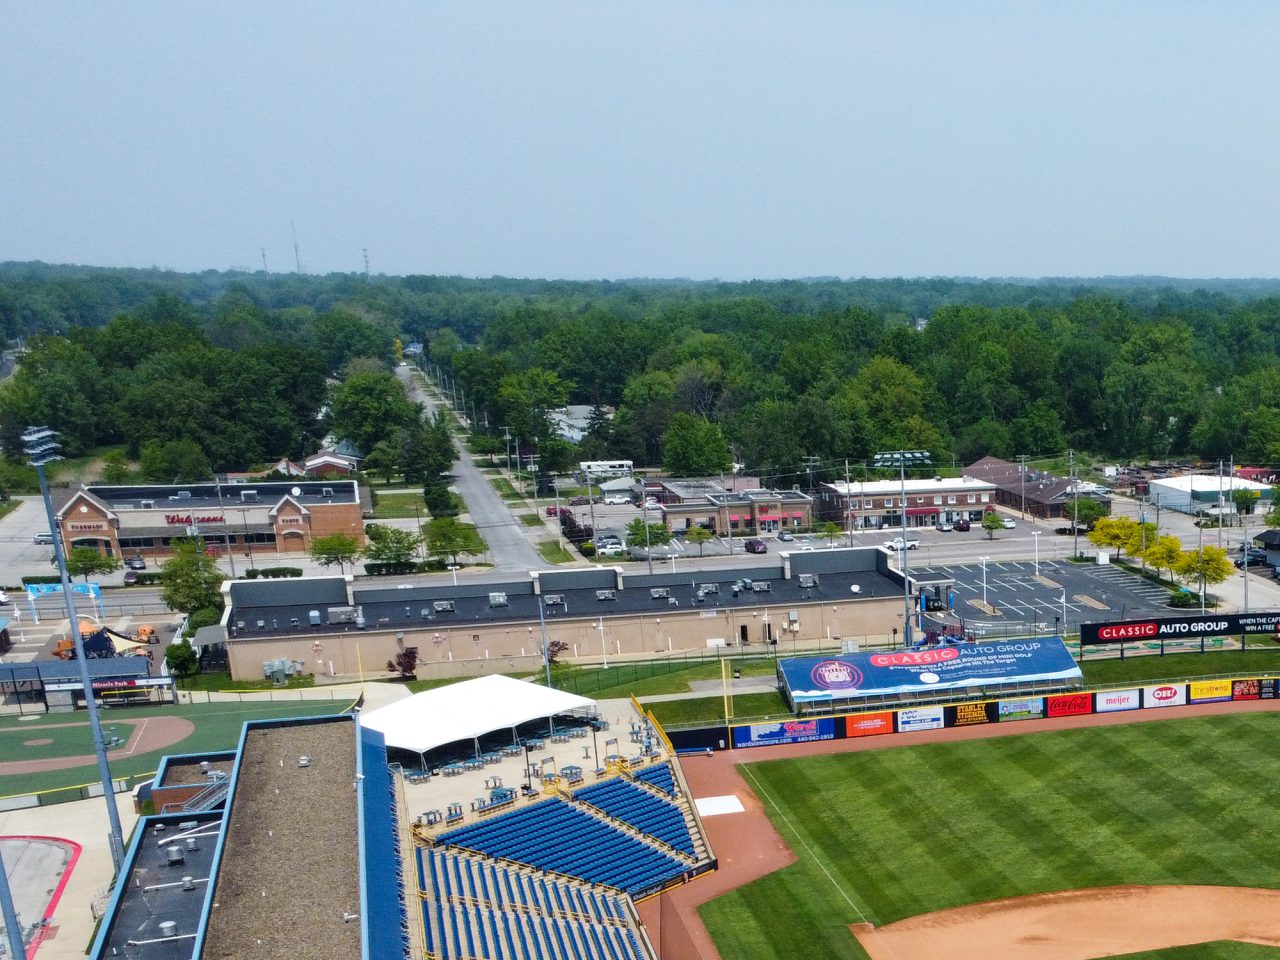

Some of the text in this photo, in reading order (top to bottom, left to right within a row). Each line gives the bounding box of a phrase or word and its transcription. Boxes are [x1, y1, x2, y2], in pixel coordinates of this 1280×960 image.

[1102, 621, 1229, 638] CLASSIC AUTO GROUP
[877, 642, 1042, 666] CLASSIC AUTO GROUP
[1153, 689, 1175, 698] OH!
[1105, 695, 1131, 706] meijer
[957, 703, 986, 712] STANLEY
